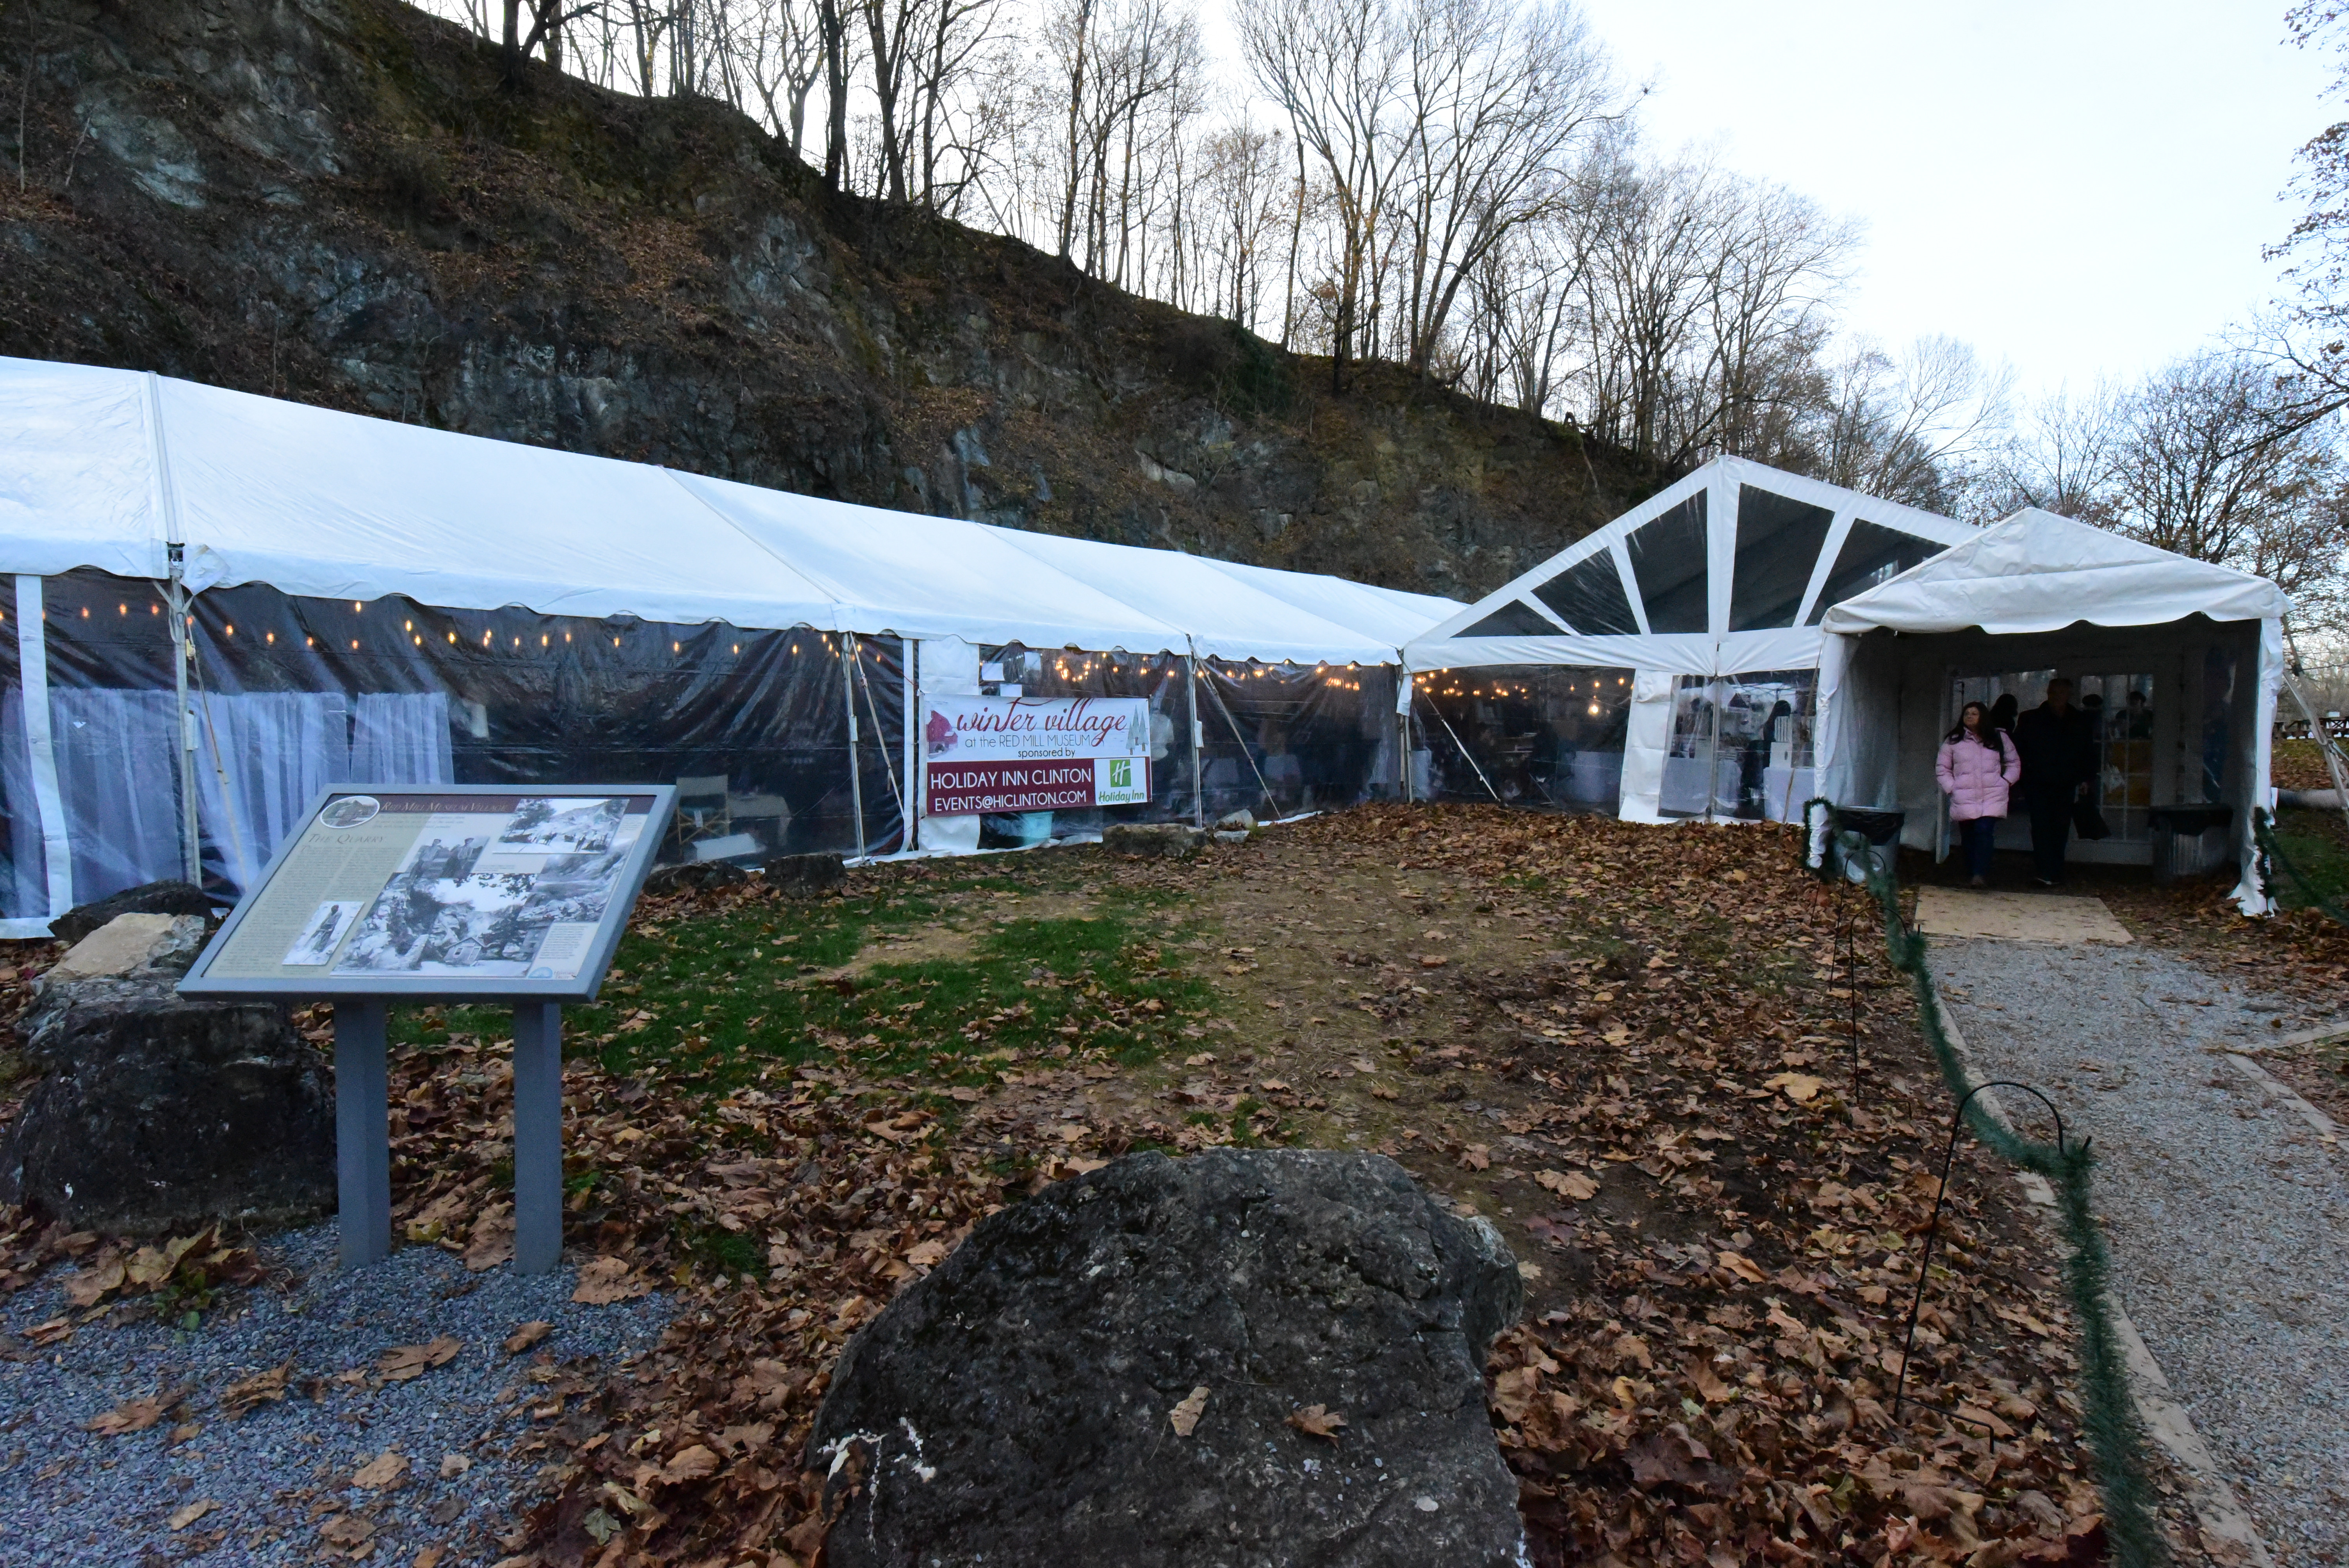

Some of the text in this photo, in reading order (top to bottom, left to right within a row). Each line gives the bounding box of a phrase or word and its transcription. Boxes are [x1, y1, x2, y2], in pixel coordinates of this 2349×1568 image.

[957, 698, 1128, 748] winter village
[965, 734, 1091, 748] at the RED MILL MUSEUM
[1018, 748, 1076, 759] sponsored by
[930, 768, 1091, 790] HOLIDAY INN CLINTON
[935, 790, 1086, 812] EVENTS@HICLINTON.COM
[1099, 789, 1144, 804] Holiday Inn
[308, 834, 384, 845] THE QUARRY
